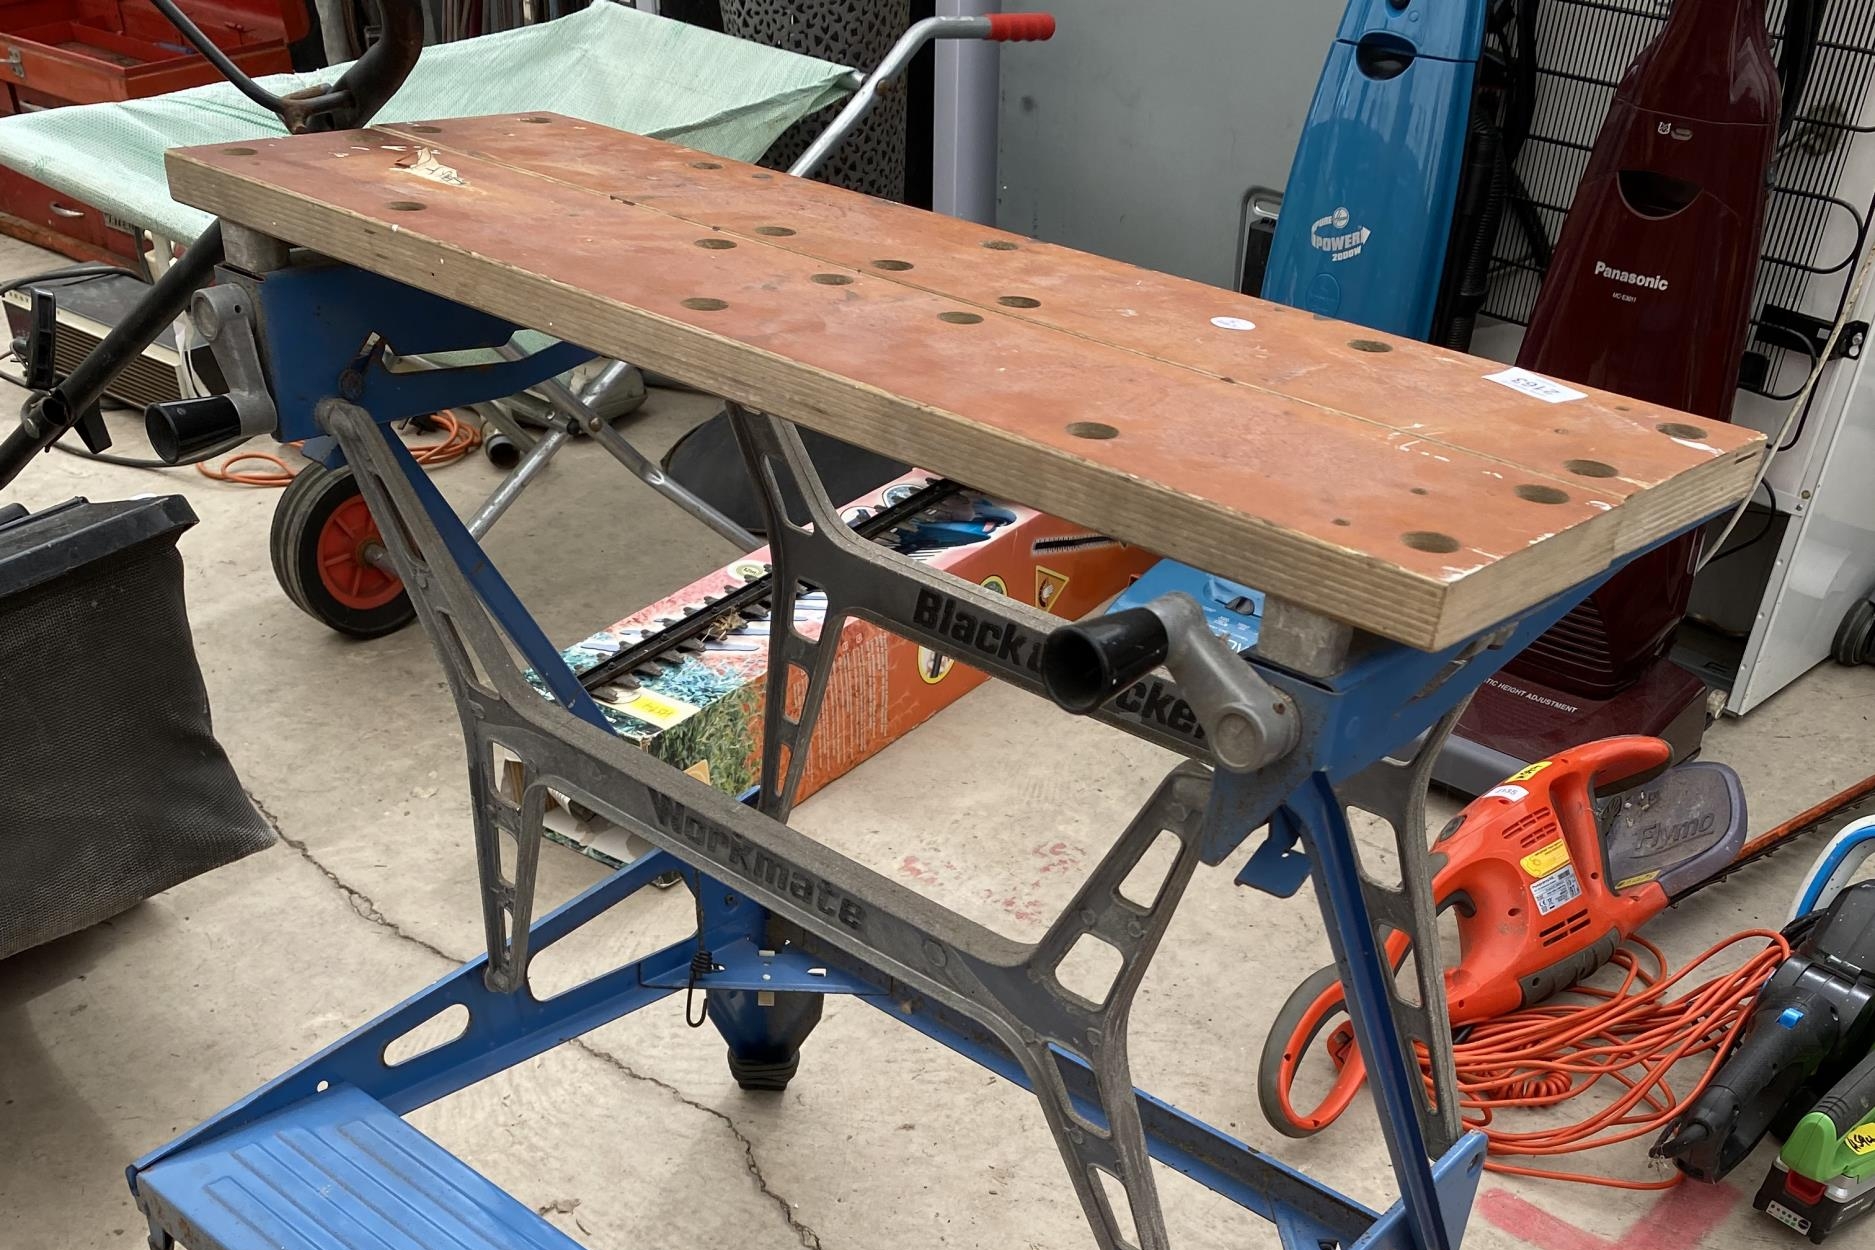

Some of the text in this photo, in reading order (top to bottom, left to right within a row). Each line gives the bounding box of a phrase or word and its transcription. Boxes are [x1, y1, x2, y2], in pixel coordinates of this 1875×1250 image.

[1315, 230, 1361, 251] POWER
[1594, 260, 1669, 291] Panasonic
[912, 587, 1029, 666] Black
[1498, 682, 1527, 697] HEIGHT
[1526, 693, 1578, 713] ADJUSTMENT
[1634, 812, 1715, 850] Flymo
[648, 786, 867, 930] Workmate
